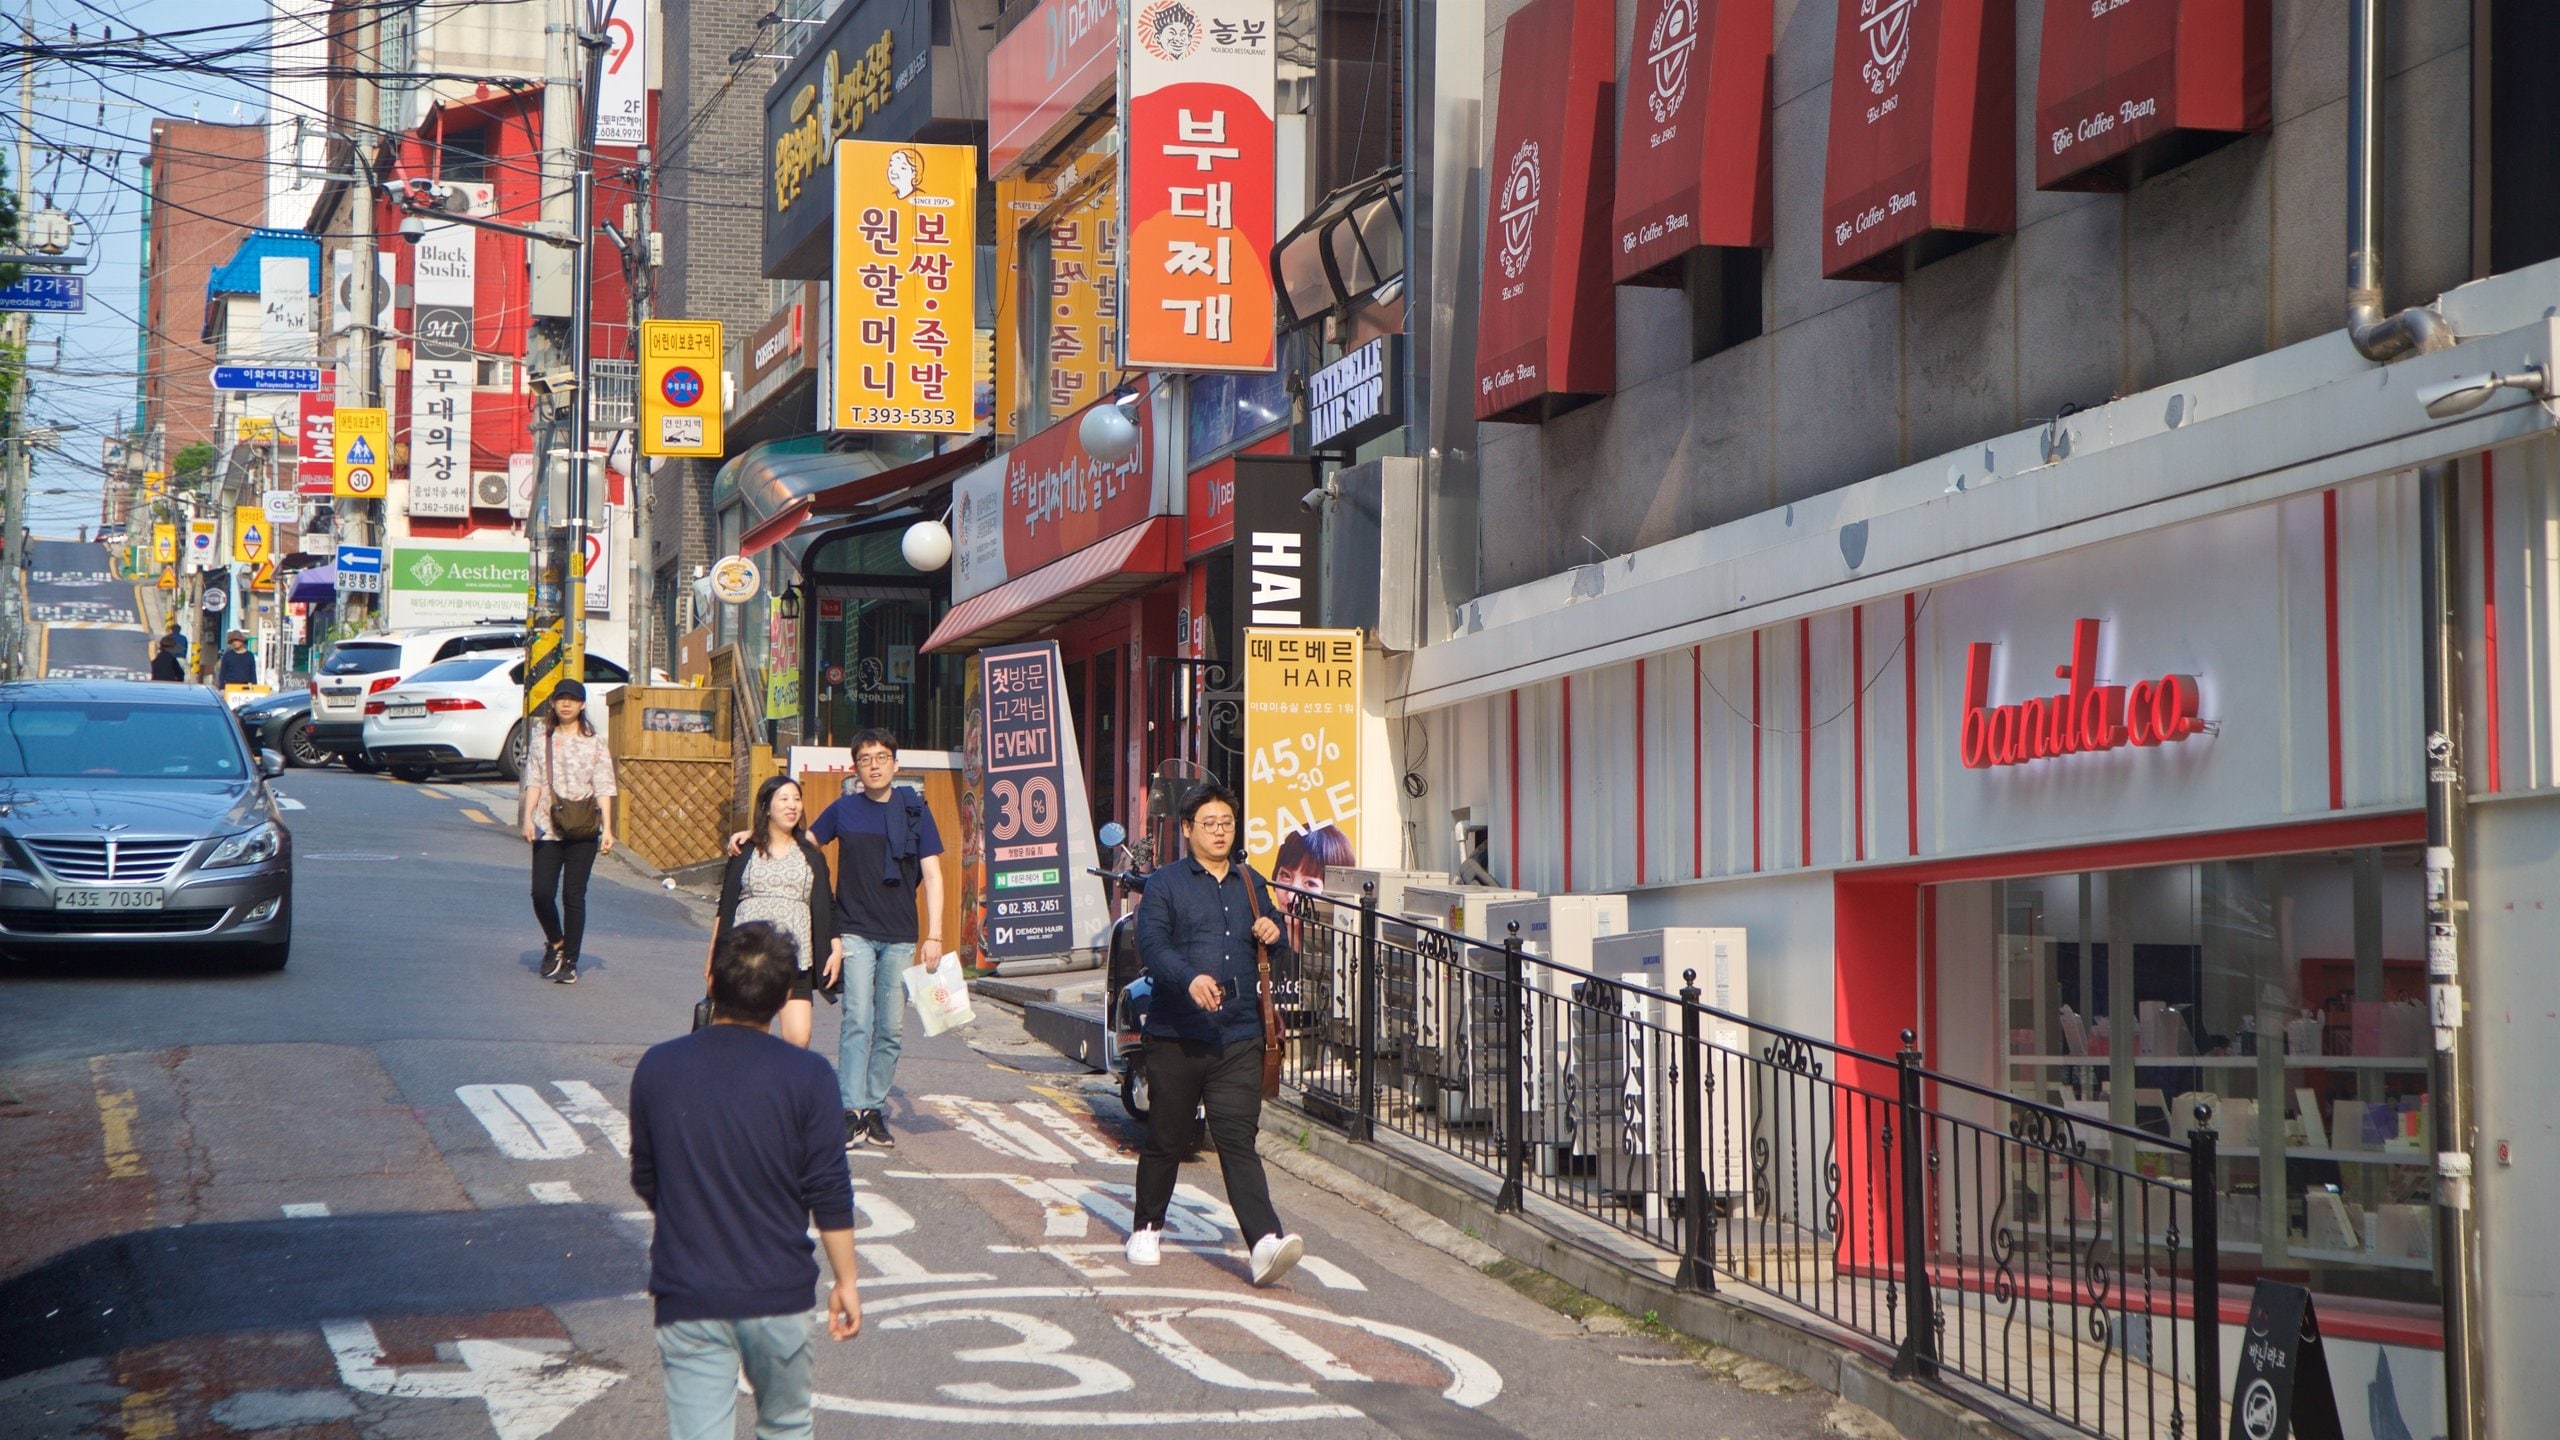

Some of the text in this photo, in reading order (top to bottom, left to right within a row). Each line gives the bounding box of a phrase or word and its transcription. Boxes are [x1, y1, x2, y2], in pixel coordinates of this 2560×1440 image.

[1210, 18, 1266, 47] 놀부
[624, 99, 641, 113] 2F
[1880, 94, 1899, 117] 1963
[1661, 126, 1677, 144] 1963
[2052, 97, 2157, 155] The Coffee Bean
[914, 198, 950, 207] SINCE 1975
[1162, 108, 1240, 343] 부대찌개
[1835, 190, 1917, 247] The Coffee Bean
[1622, 213, 1689, 254] The Coffee Bean
[421, 245, 468, 263] Black
[418, 262, 472, 279] Sushi.
[6, 278, 80, 296] 대2가길
[44, 298, 79, 310] 2ga-gil
[858, 208, 904, 399] 원할머니
[426, 320, 459, 338] MI
[653, 332, 712, 352] 어린이보호구역
[243, 369, 317, 381] 이화여대2나길
[1482, 363, 1537, 396] The Coffee Bean
[256, 381, 294, 390] Ewhayeodae
[852, 406, 955, 425] T.393-5353
[1310, 376, 1383, 447] HAIR SHOP
[426, 368, 457, 481] 무대의상
[665, 418, 702, 429] 견인지역
[353, 473, 369, 487] 30
[1026, 455, 1078, 537] 부대찌개
[1079, 470, 1088, 513] &
[414, 502, 465, 513] T.362-5864
[339, 572, 377, 589] 일방통행
[447, 562, 529, 581] Aesthera
[1251, 639, 1353, 663] 떼뜨베르
[992, 664, 1045, 695] 첫방문
[1284, 668, 1352, 688] HAIR
[1961, 618, 2128, 770] banila
[993, 695, 1046, 723] 고객님
[1250, 702, 1299, 713] 이대미용실
[1303, 702, 1334, 714] 선호도
[994, 728, 1047, 759] EVENT
[1251, 727, 1340, 785] 45%
[1246, 780, 1361, 855] SALE
[109, 891, 153, 907] 7030
[1015, 925, 1064, 936] DEMON HAIR
[1531, 922, 1548, 931] SAMSUNG
[1642, 955, 1661, 965] SAMSUNG
[2249, 1339, 2287, 1372] 바닐라코
